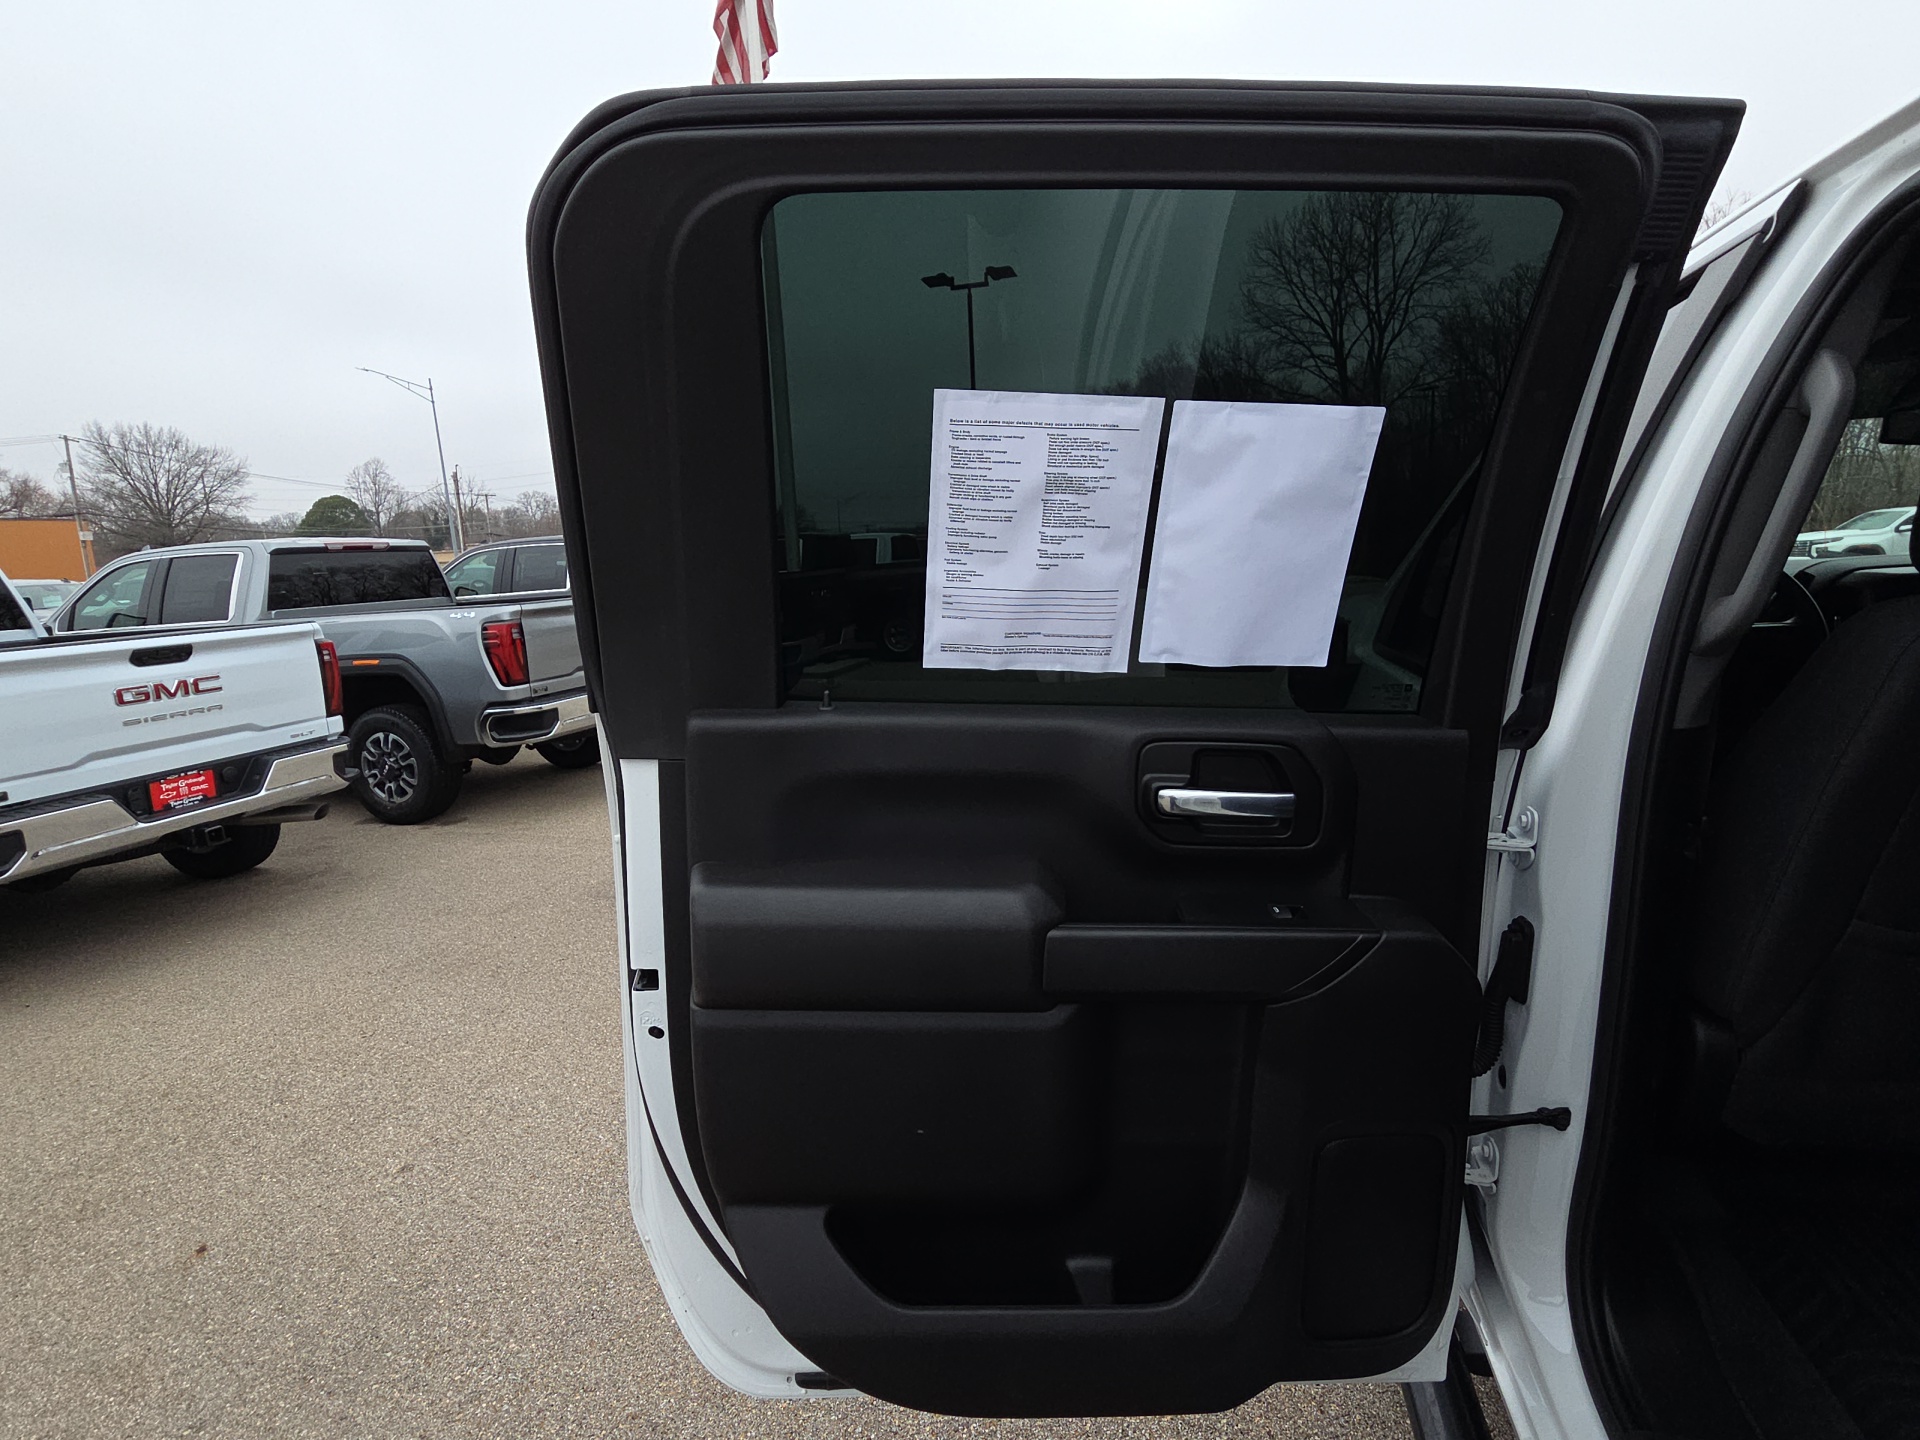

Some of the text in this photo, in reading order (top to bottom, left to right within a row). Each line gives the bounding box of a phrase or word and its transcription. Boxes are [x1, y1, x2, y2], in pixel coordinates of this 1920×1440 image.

[113, 673, 223, 707] GMC
[122, 704, 224, 726] SIERRA
[290, 729, 315, 738] SLT
[160, 782, 178, 791] Taylor
